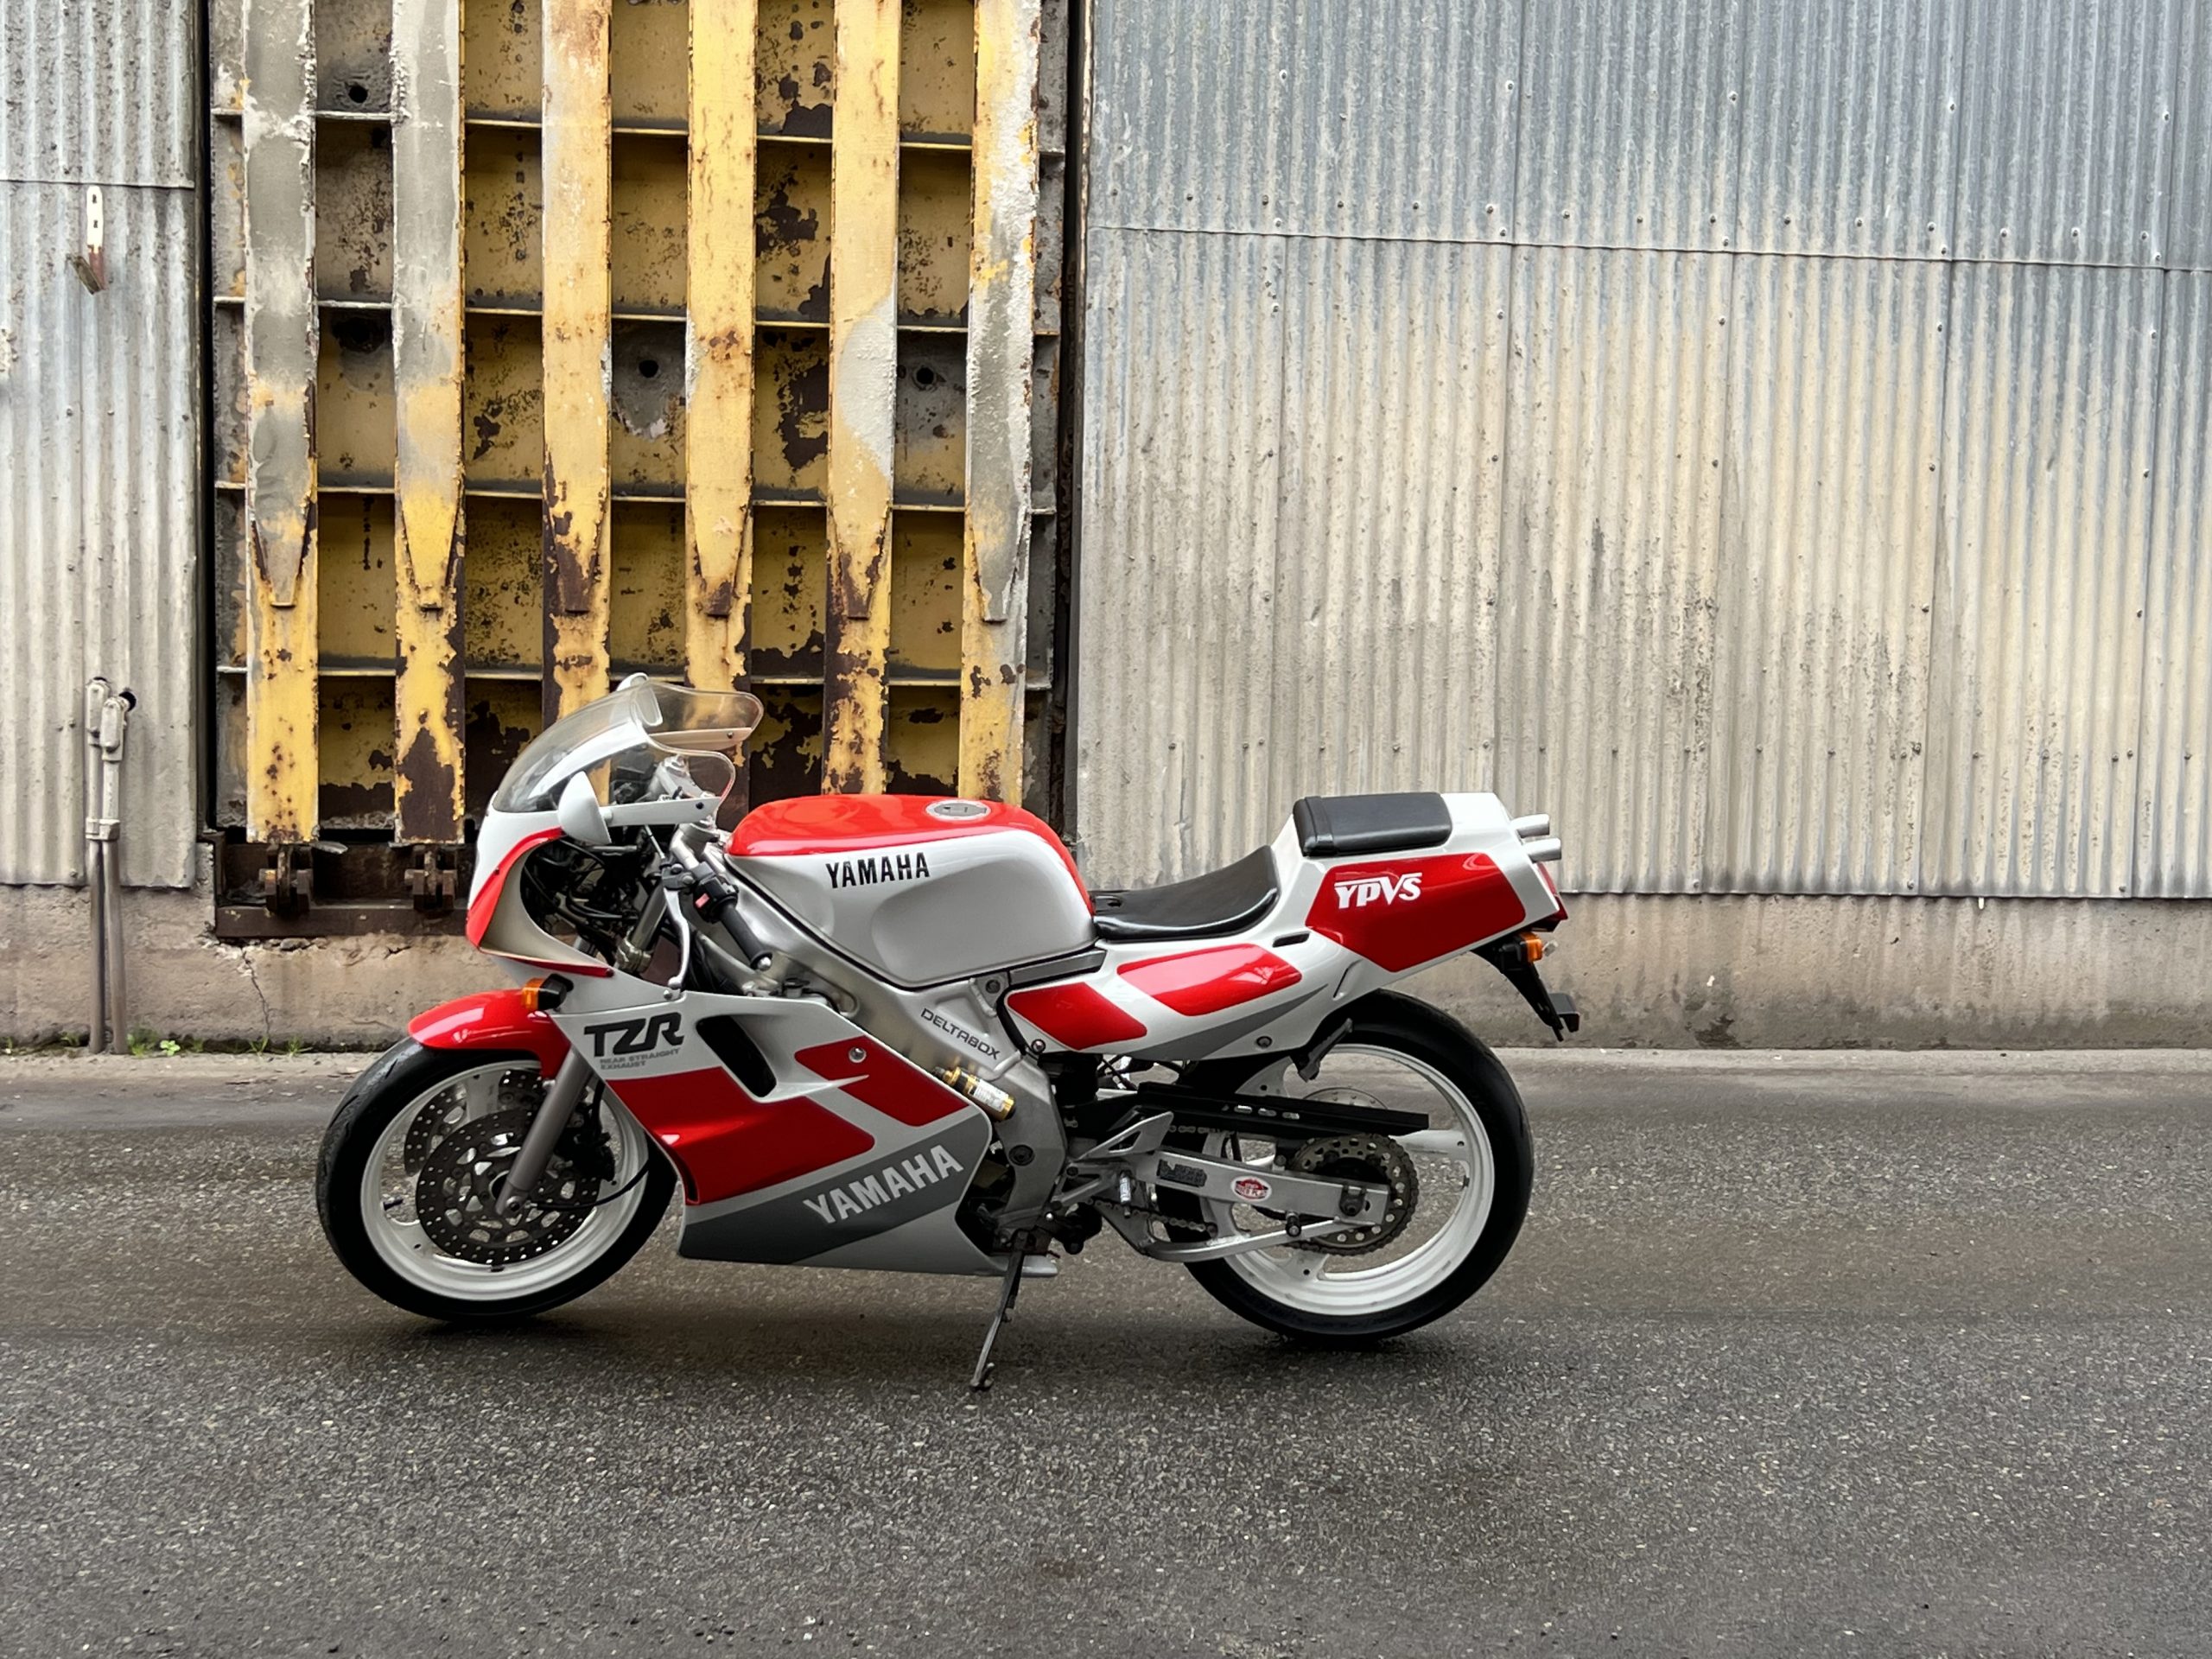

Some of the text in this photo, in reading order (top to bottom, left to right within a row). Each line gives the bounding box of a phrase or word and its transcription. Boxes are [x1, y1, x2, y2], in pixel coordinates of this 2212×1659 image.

[825, 852, 930, 888] YAMAHA
[1334, 872, 1422, 909] YPVS
[584, 1012, 684, 1057] TZR
[920, 1007, 1001, 1060] DELTABOX
[601, 1060, 646, 1070] EXHAUST
[628, 1048, 681, 1062] STRAIGHT
[803, 1144, 963, 1224] YAMAHA
